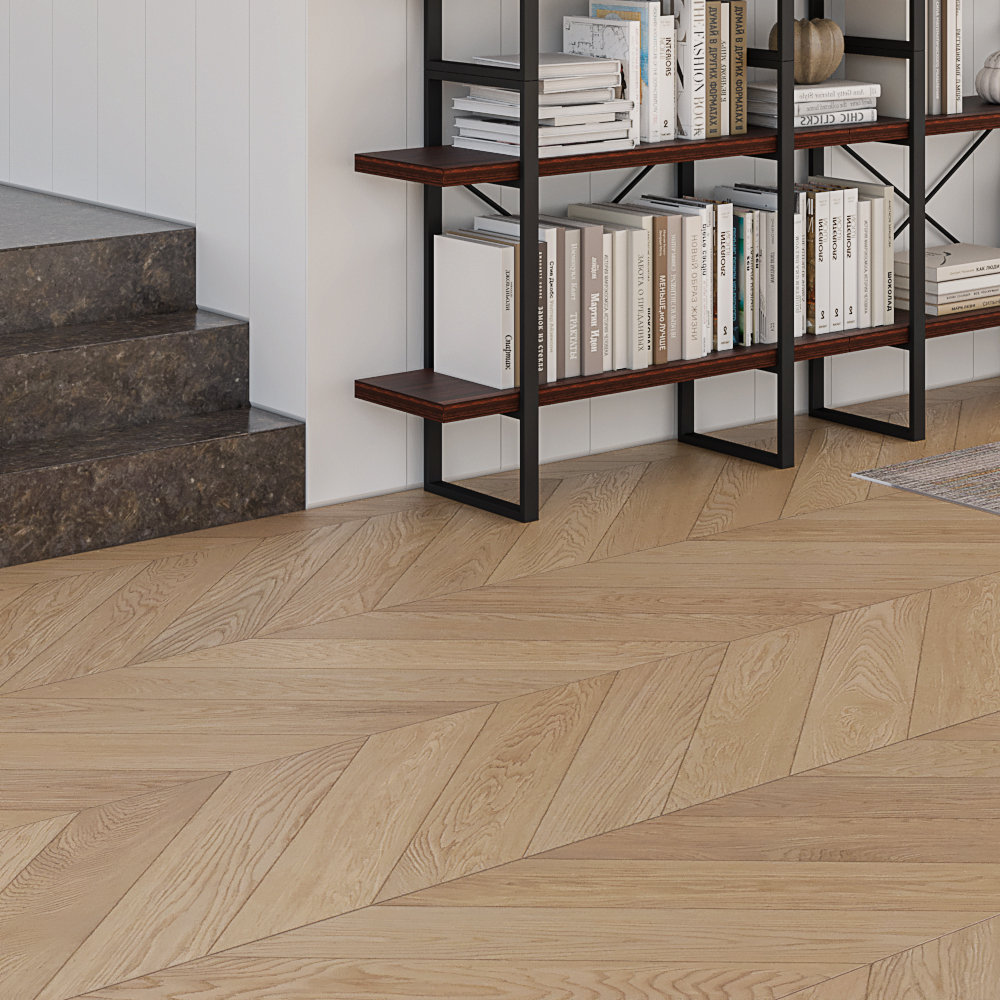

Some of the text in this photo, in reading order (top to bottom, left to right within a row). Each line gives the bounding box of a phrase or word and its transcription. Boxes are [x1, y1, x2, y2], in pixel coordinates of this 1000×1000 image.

[709, 7, 719, 36] ДУМАЙ
[735, 6, 745, 35] ДУМАЙ
[693, 0, 704, 137] THE FASHION BOOK
[709, 46, 718, 79] ДРУГИХ
[735, 45, 744, 76] ДРУГИХ
[709, 81, 718, 125] ФОРМАТАХ
[735, 79, 744, 123] ФОРМАТАХ
[663, 119, 669, 127] 2
[637, 255, 645, 287] ЗАБОТА
[690, 234, 698, 341] НОВЫЙ ОБРАЗ ЖИЗНИ
[570, 312, 578, 361] ТРАКТАТЫ
[589, 293, 600, 353] Мартин Иден
[637, 298, 645, 353] ПРЕДАННЫХ
[658, 323, 666, 351] ЛУЧШЕ
[503, 334, 513, 371] Спартак
